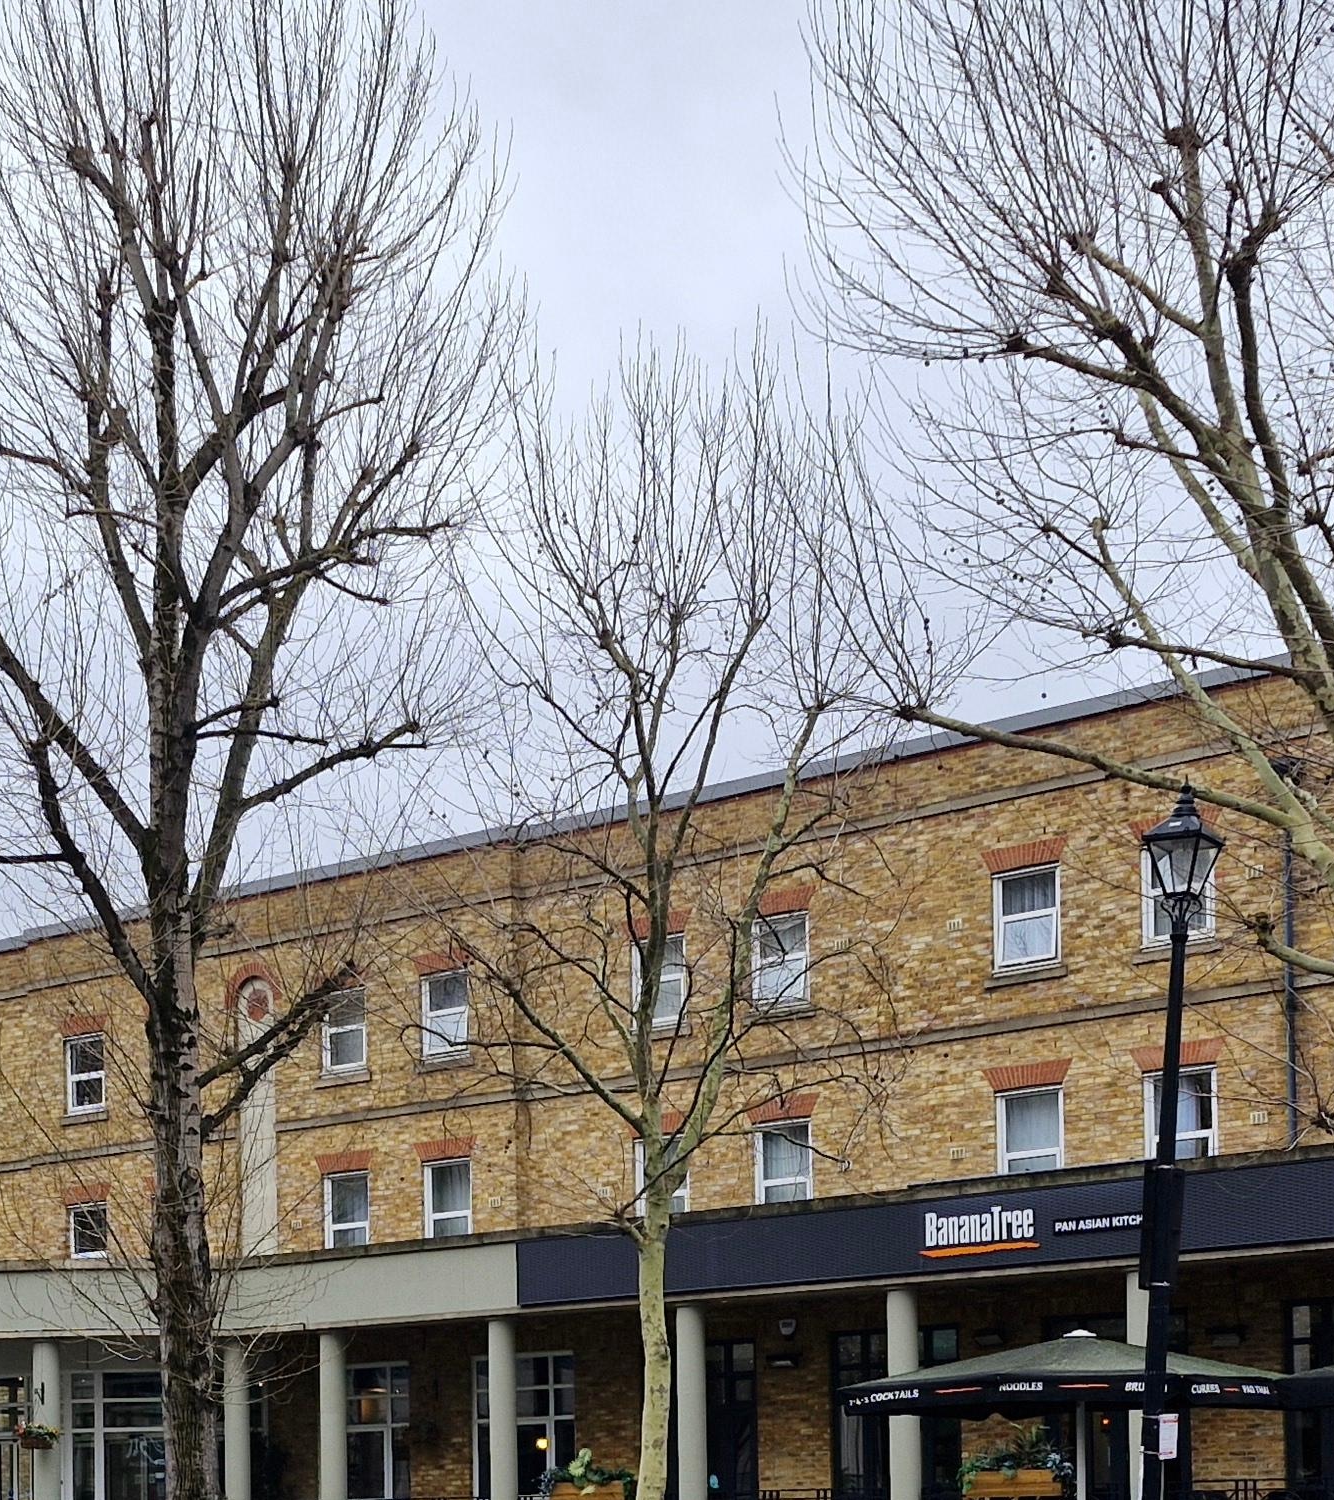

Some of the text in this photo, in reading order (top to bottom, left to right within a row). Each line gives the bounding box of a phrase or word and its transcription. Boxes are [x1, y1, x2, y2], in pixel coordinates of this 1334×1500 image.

[924, 1206, 1035, 1247] BananaTree
[1055, 1214, 1144, 1232] PAN ASIAN KITCH
[999, 1381, 1043, 1392] NOODLES
[870, 1389, 919, 1402] COCKTAILS
